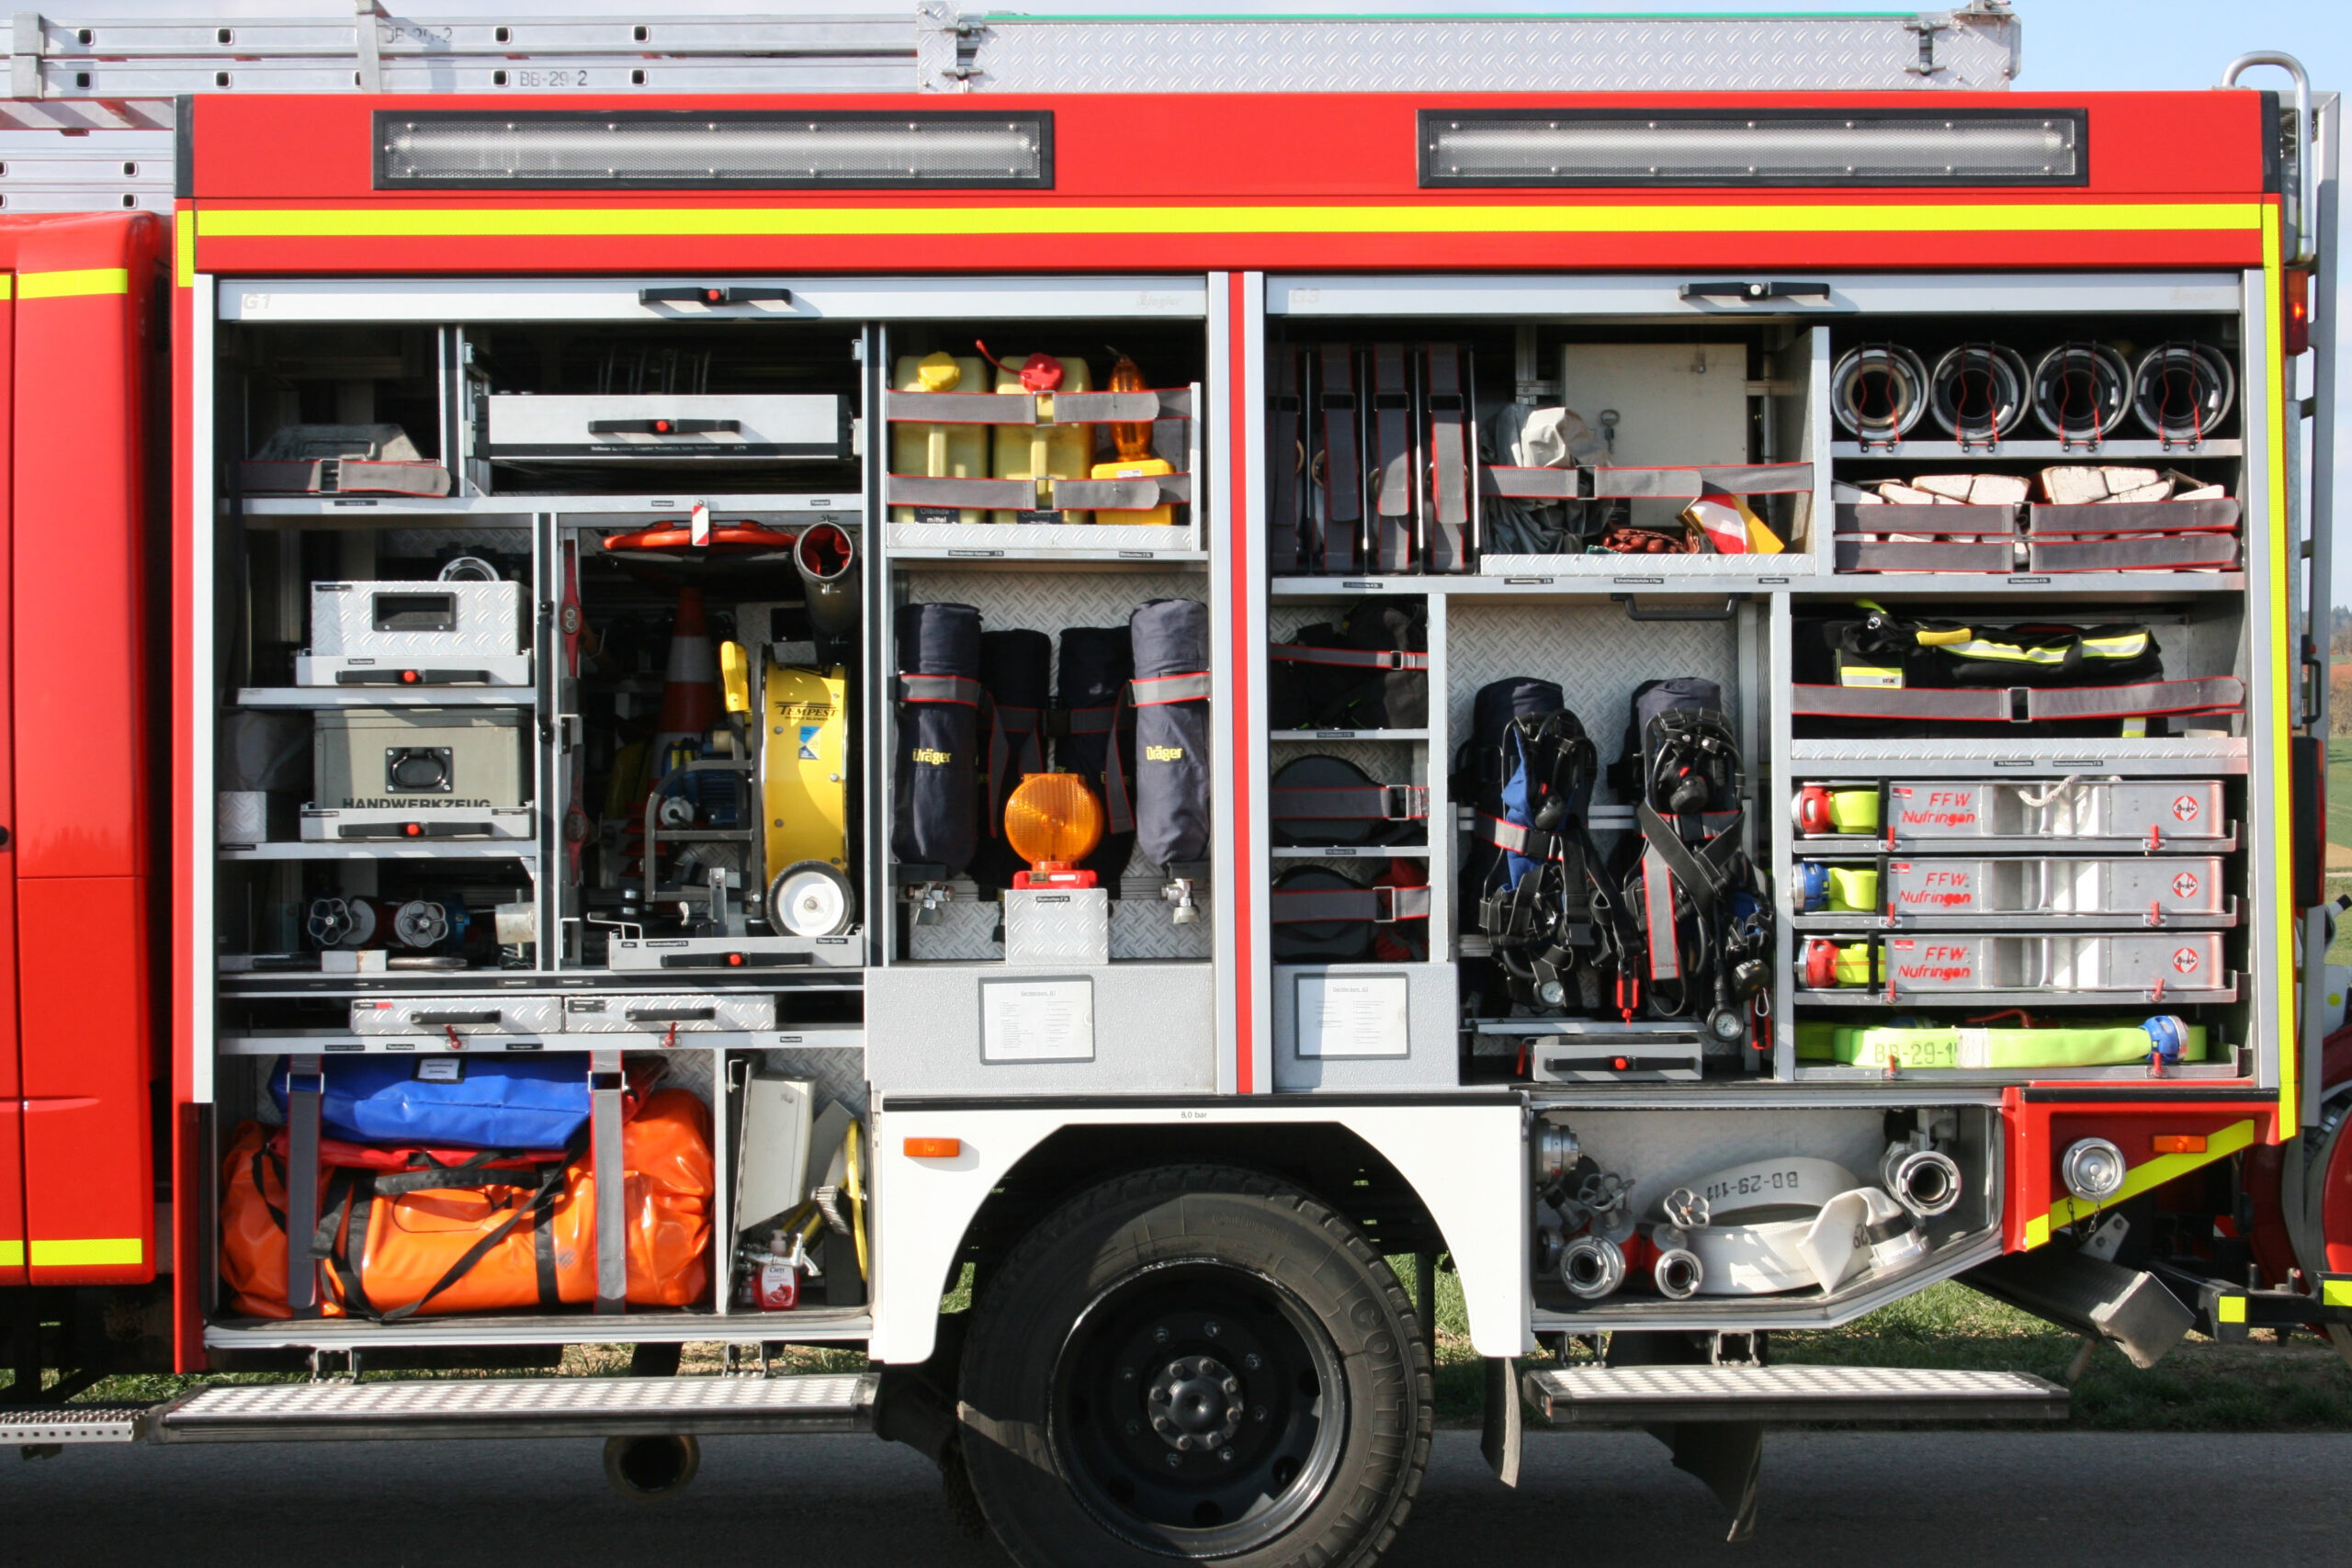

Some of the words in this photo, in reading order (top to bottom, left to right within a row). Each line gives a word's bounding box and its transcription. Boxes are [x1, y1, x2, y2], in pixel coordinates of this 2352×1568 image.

[243, 293, 272, 310] G1
[776, 704, 839, 717] TEMPEST
[912, 747, 952, 765] Dräger
[1146, 745, 1183, 762] Dräger
[343, 797, 492, 808] HANDWERKZEUG
[1928, 792, 1972, 807] FFW
[1925, 872, 1968, 887] FFW
[1924, 946, 1967, 962] FFW
